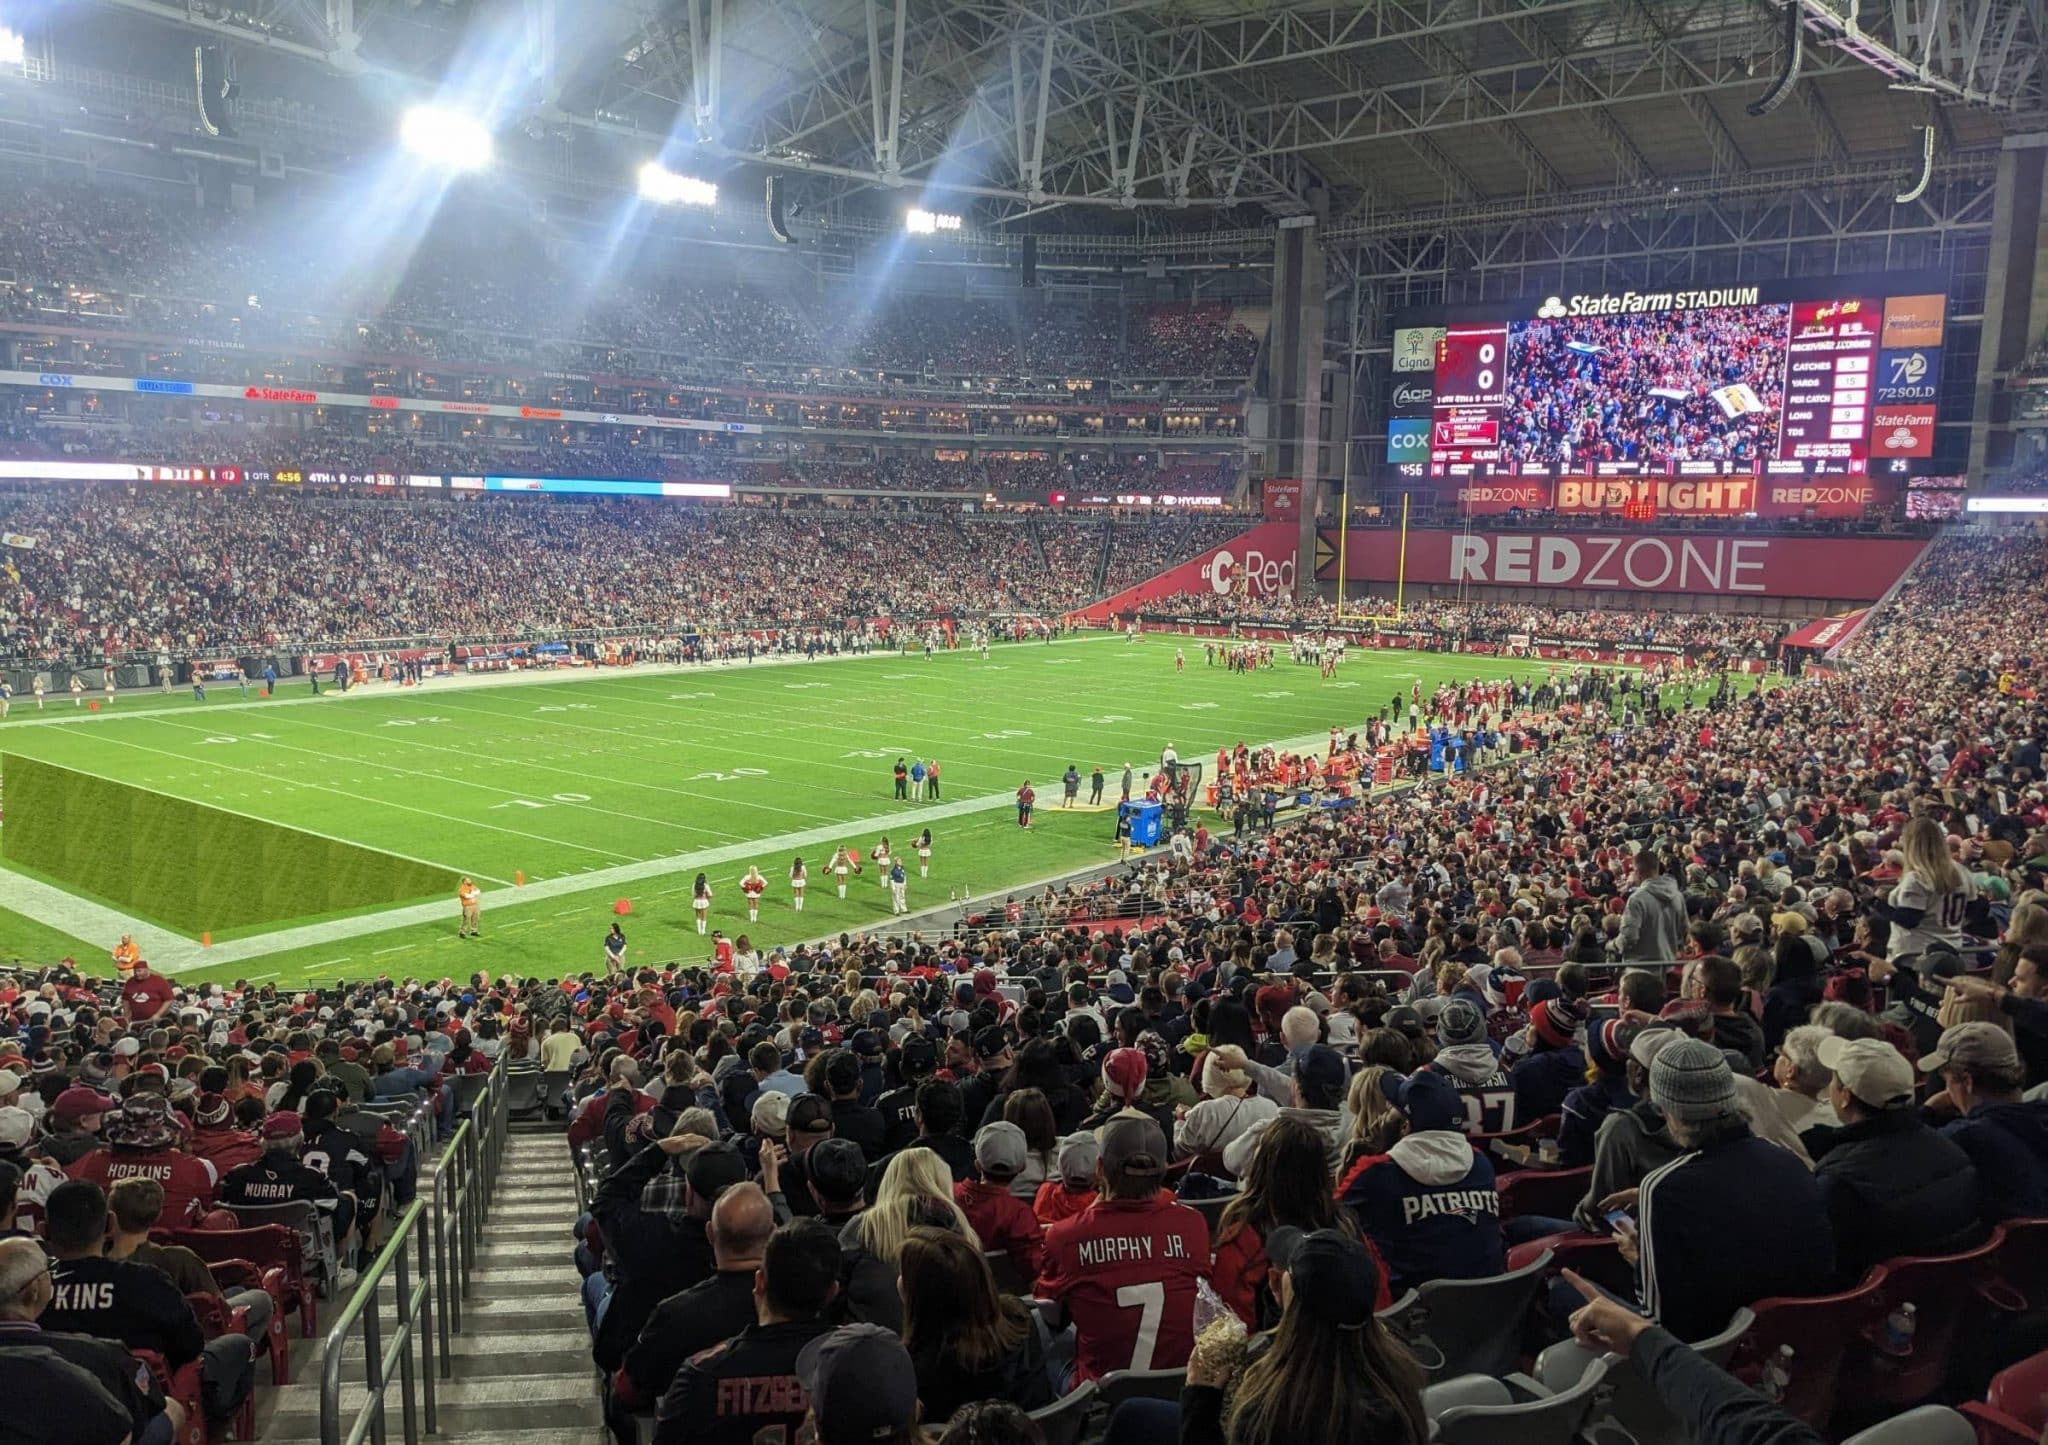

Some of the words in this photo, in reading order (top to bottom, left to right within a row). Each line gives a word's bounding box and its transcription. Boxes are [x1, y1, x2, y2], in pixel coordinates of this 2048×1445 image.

[1675, 287, 1758, 309] STADIUM
[1479, 343, 1495, 364] 0
[1398, 357, 1430, 371] Cigna
[1792, 361, 1831, 371] CATCHES
[39, 373, 73, 386] COX
[1478, 369, 1494, 389] 0
[1791, 378, 1820, 387] YARDS
[1400, 389, 1432, 401] ACP
[1879, 387, 1935, 400] 72SOLD
[1788, 411, 1813, 420] LONG
[1391, 433, 1429, 448] COX
[1400, 463, 1423, 477] 4:56
[1890, 459, 1908, 472] 25
[275, 472, 301, 483] 4:56
[1177, 496, 1221, 505] HYUNDAI
[1458, 486, 1538, 502] REDZONE
[1557, 481, 1632, 508] BUD
[1771, 487, 1874, 503] REDZONE
[1245, 549, 1296, 591] Red
[1450, 534, 1769, 591] REDZONE
[696, 767, 769, 782] 20
[498, 792, 593, 808] 10
[107, 1162, 172, 1180] HOPKINS
[244, 1182, 295, 1199] MURRAY
[1402, 1189, 1500, 1226] PATRIOTS
[1078, 1236, 1152, 1267] MURPHY
[1163, 1234, 1190, 1260] JR.
[50, 1282, 115, 1311] KINS
[1116, 1281, 1165, 1372] 7
